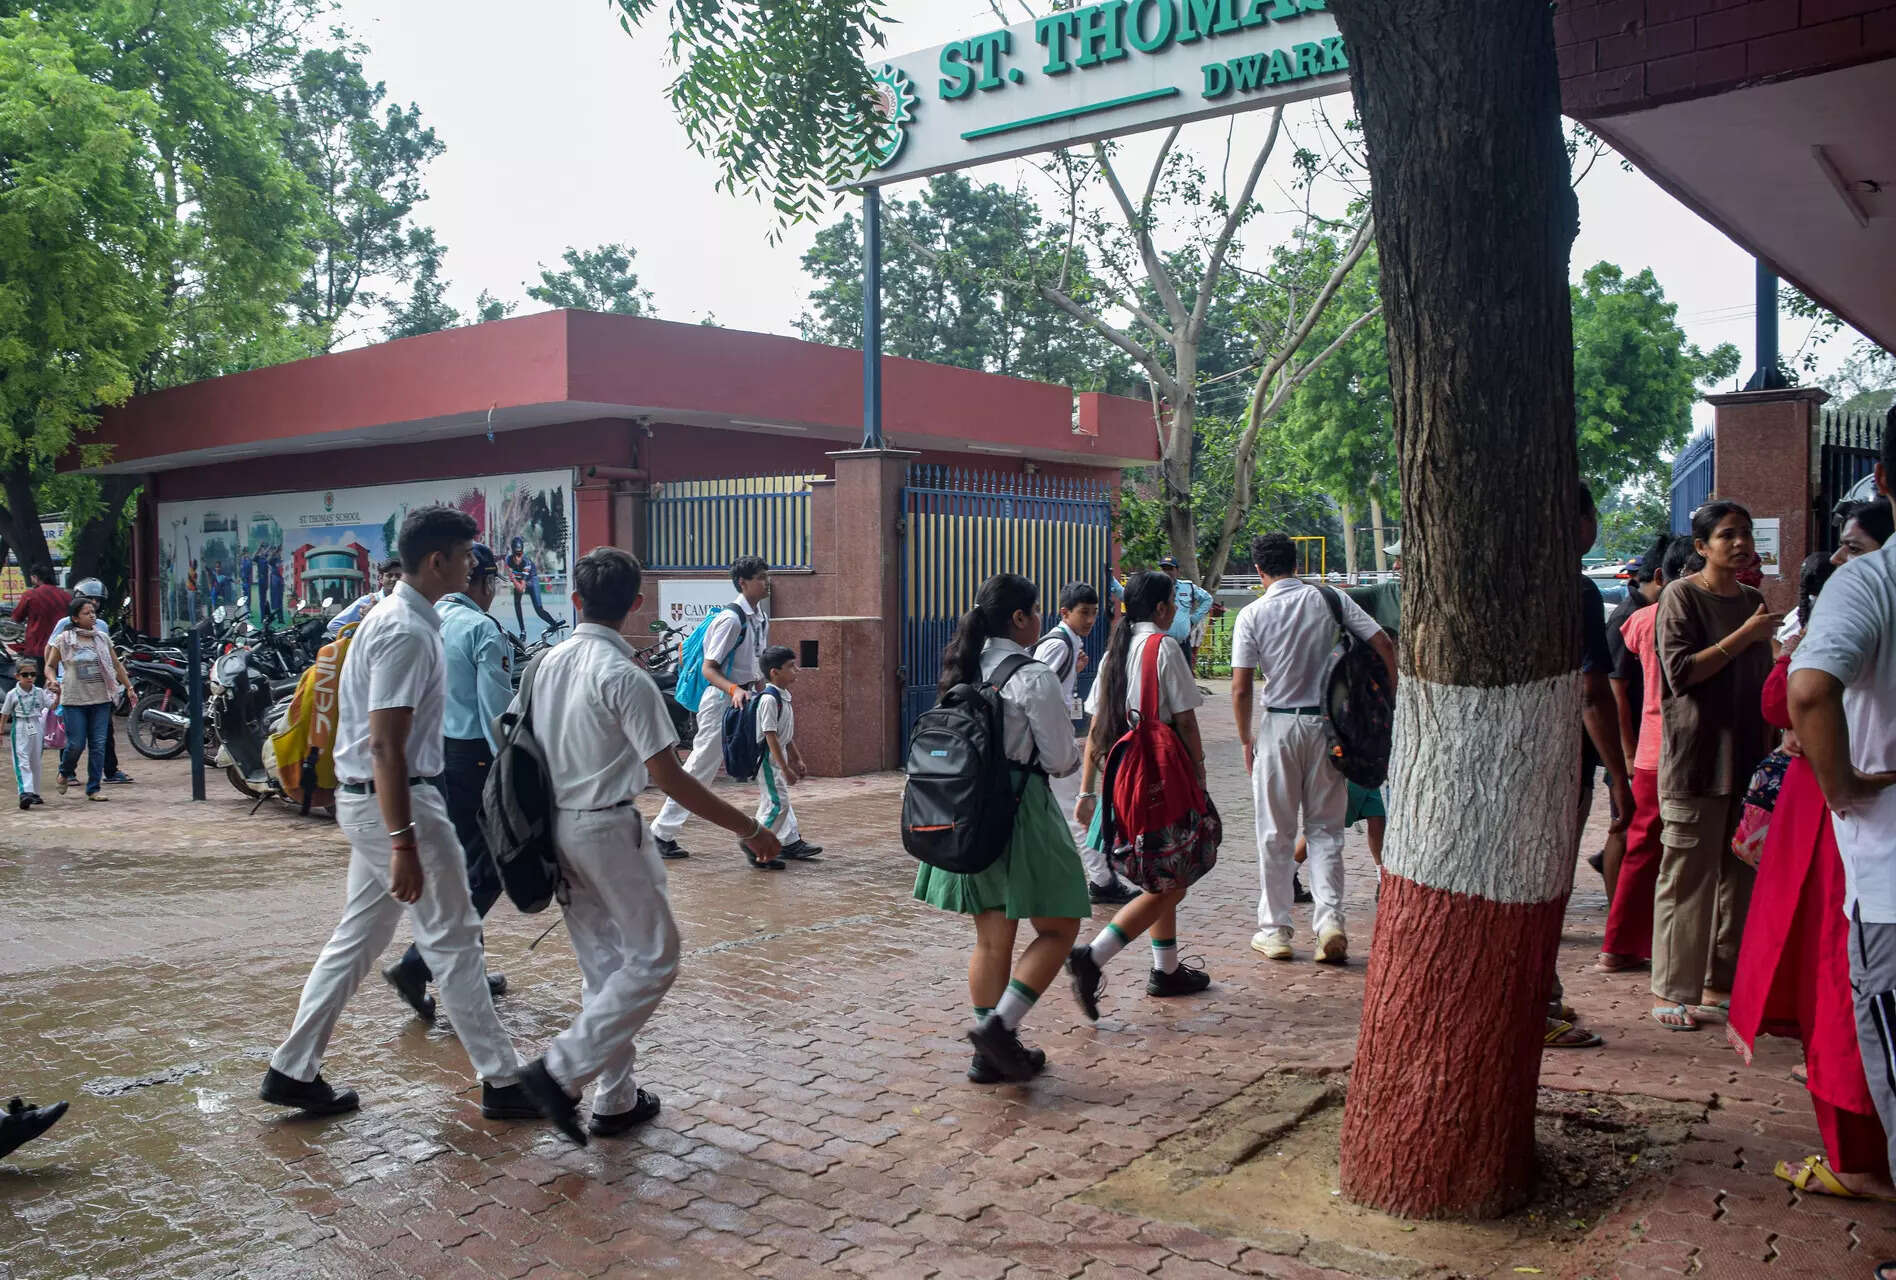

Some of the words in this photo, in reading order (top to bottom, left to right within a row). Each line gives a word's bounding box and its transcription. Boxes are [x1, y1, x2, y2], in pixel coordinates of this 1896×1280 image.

[938, 29, 1023, 100] ST.
[1035, 0, 1327, 74] THOM
[1201, 35, 1350, 97] DWARK
